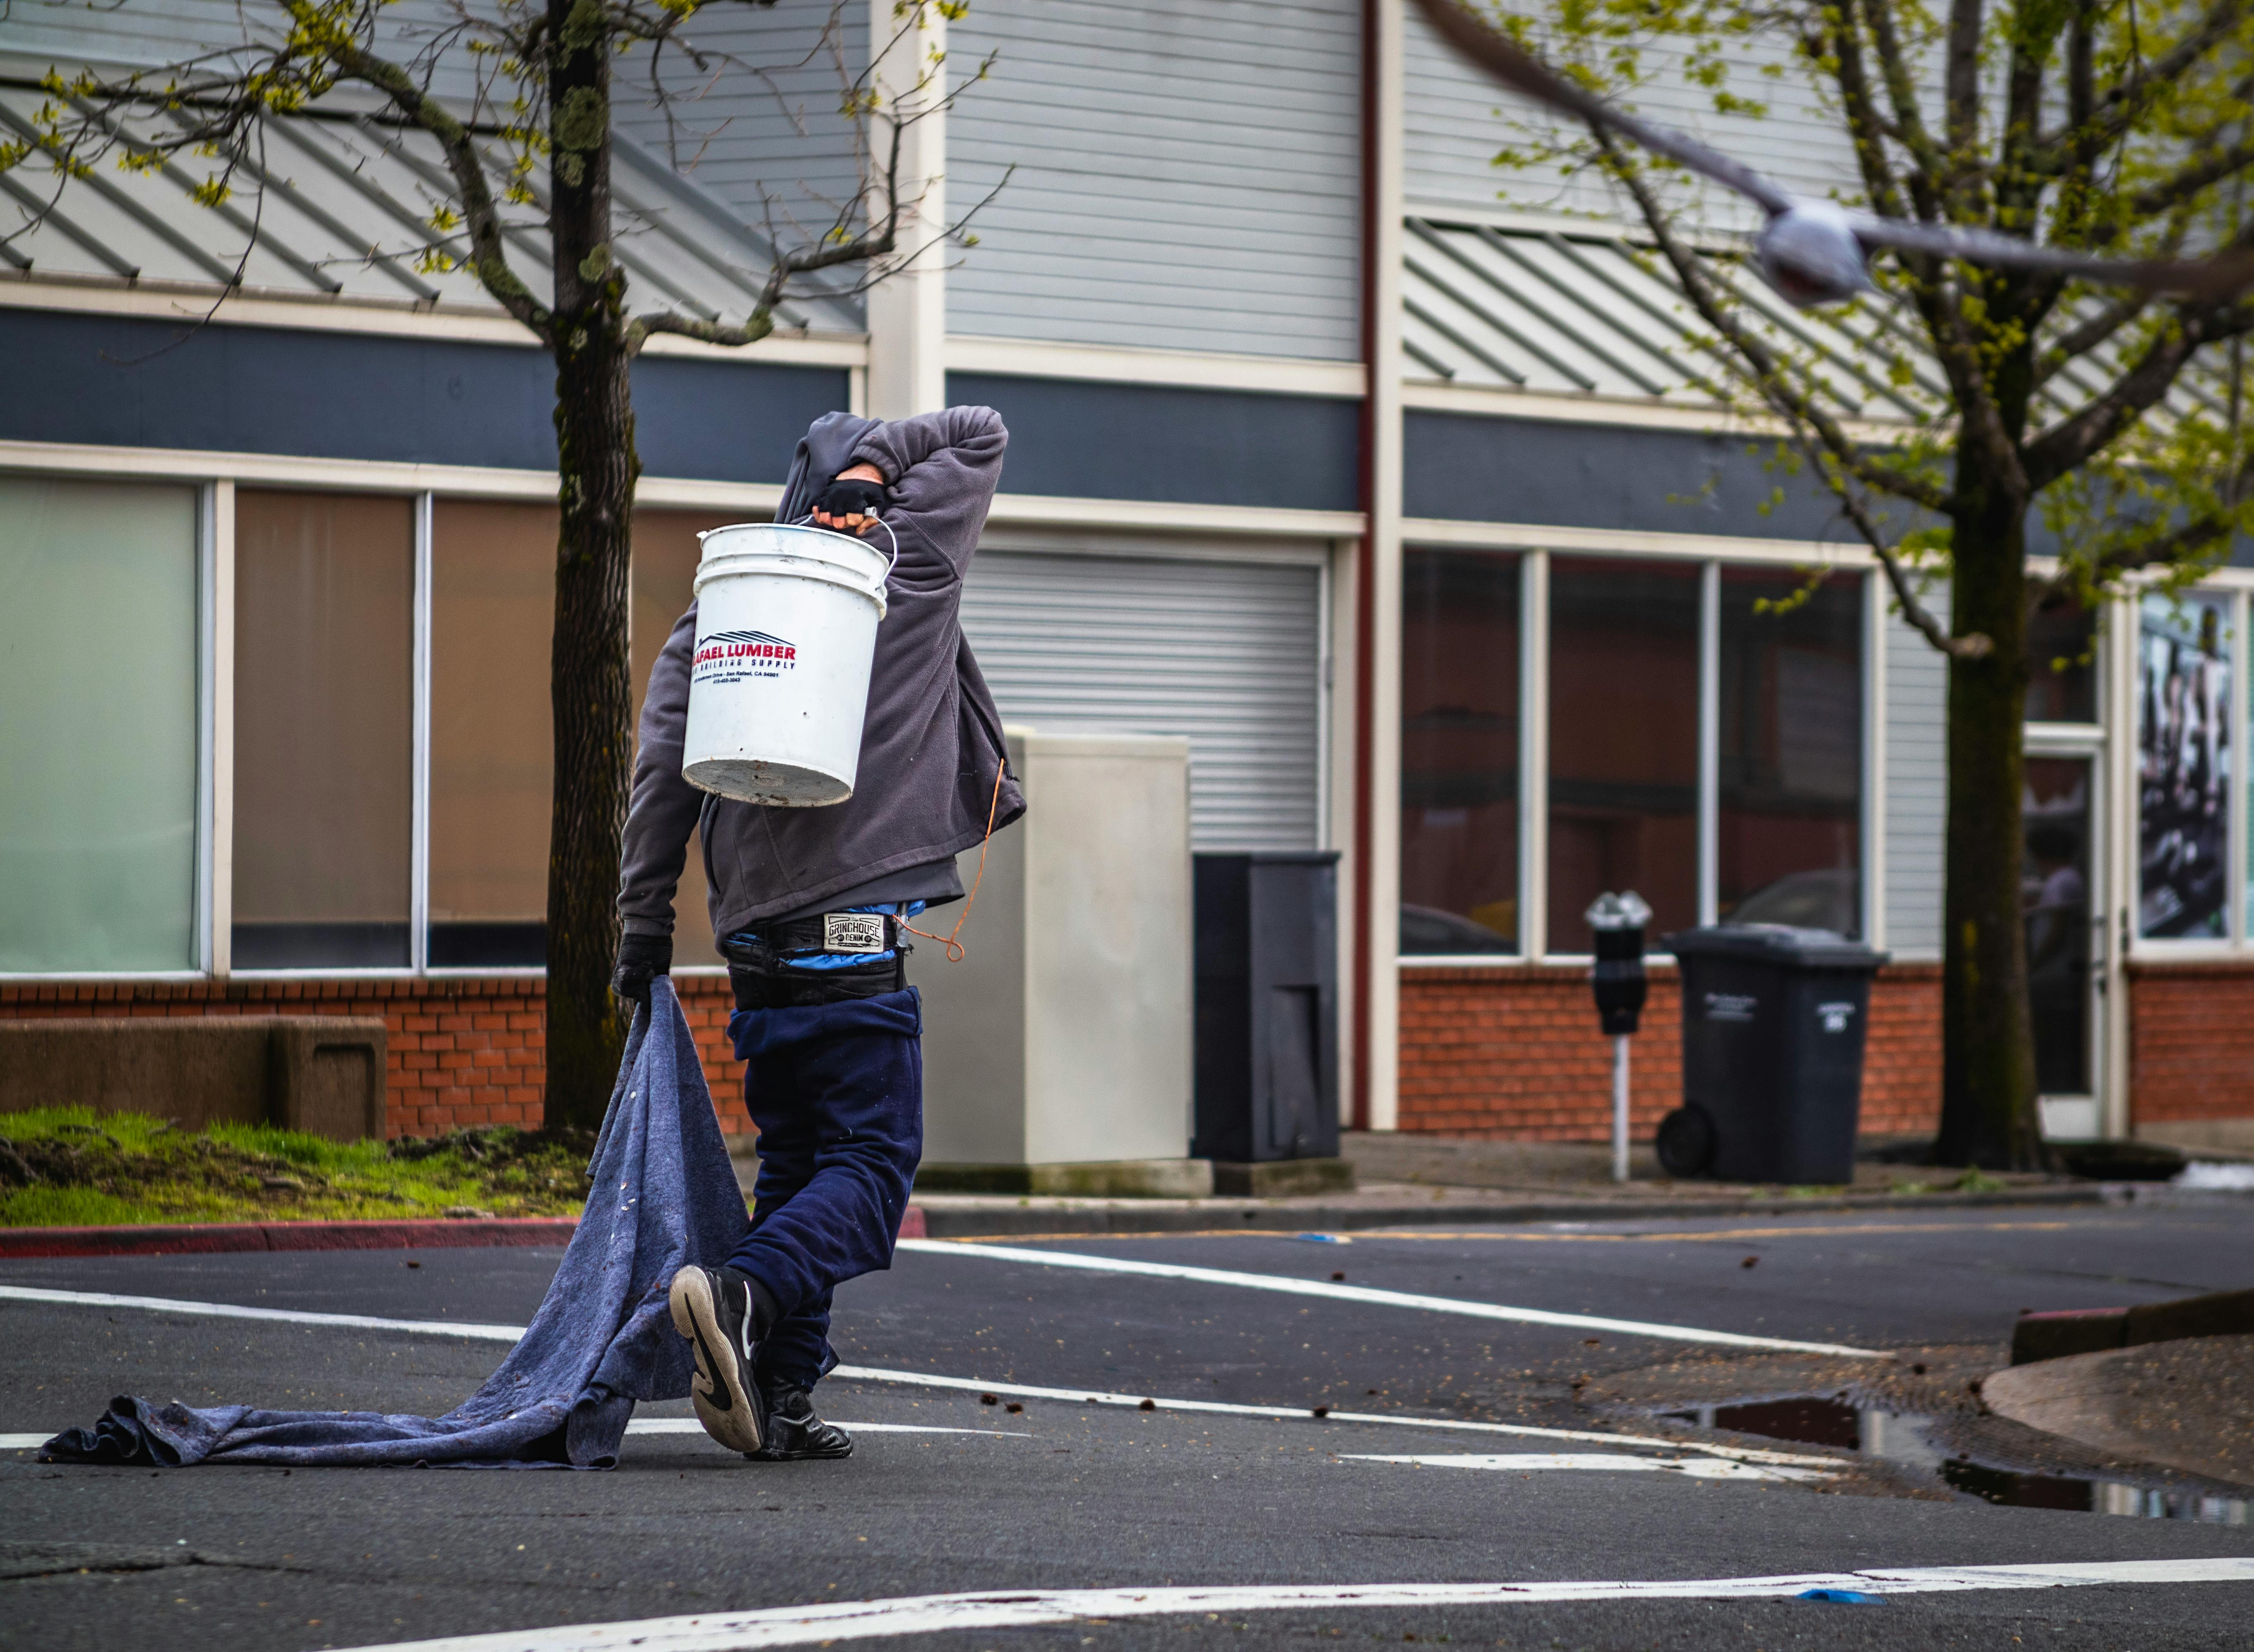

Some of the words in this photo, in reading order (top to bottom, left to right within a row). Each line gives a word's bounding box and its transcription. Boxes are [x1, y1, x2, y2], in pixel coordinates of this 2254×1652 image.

[727, 644, 796, 660] LUMBER
[701, 659, 741, 671] BUILDING
[751, 659, 794, 669] SUPPLY
